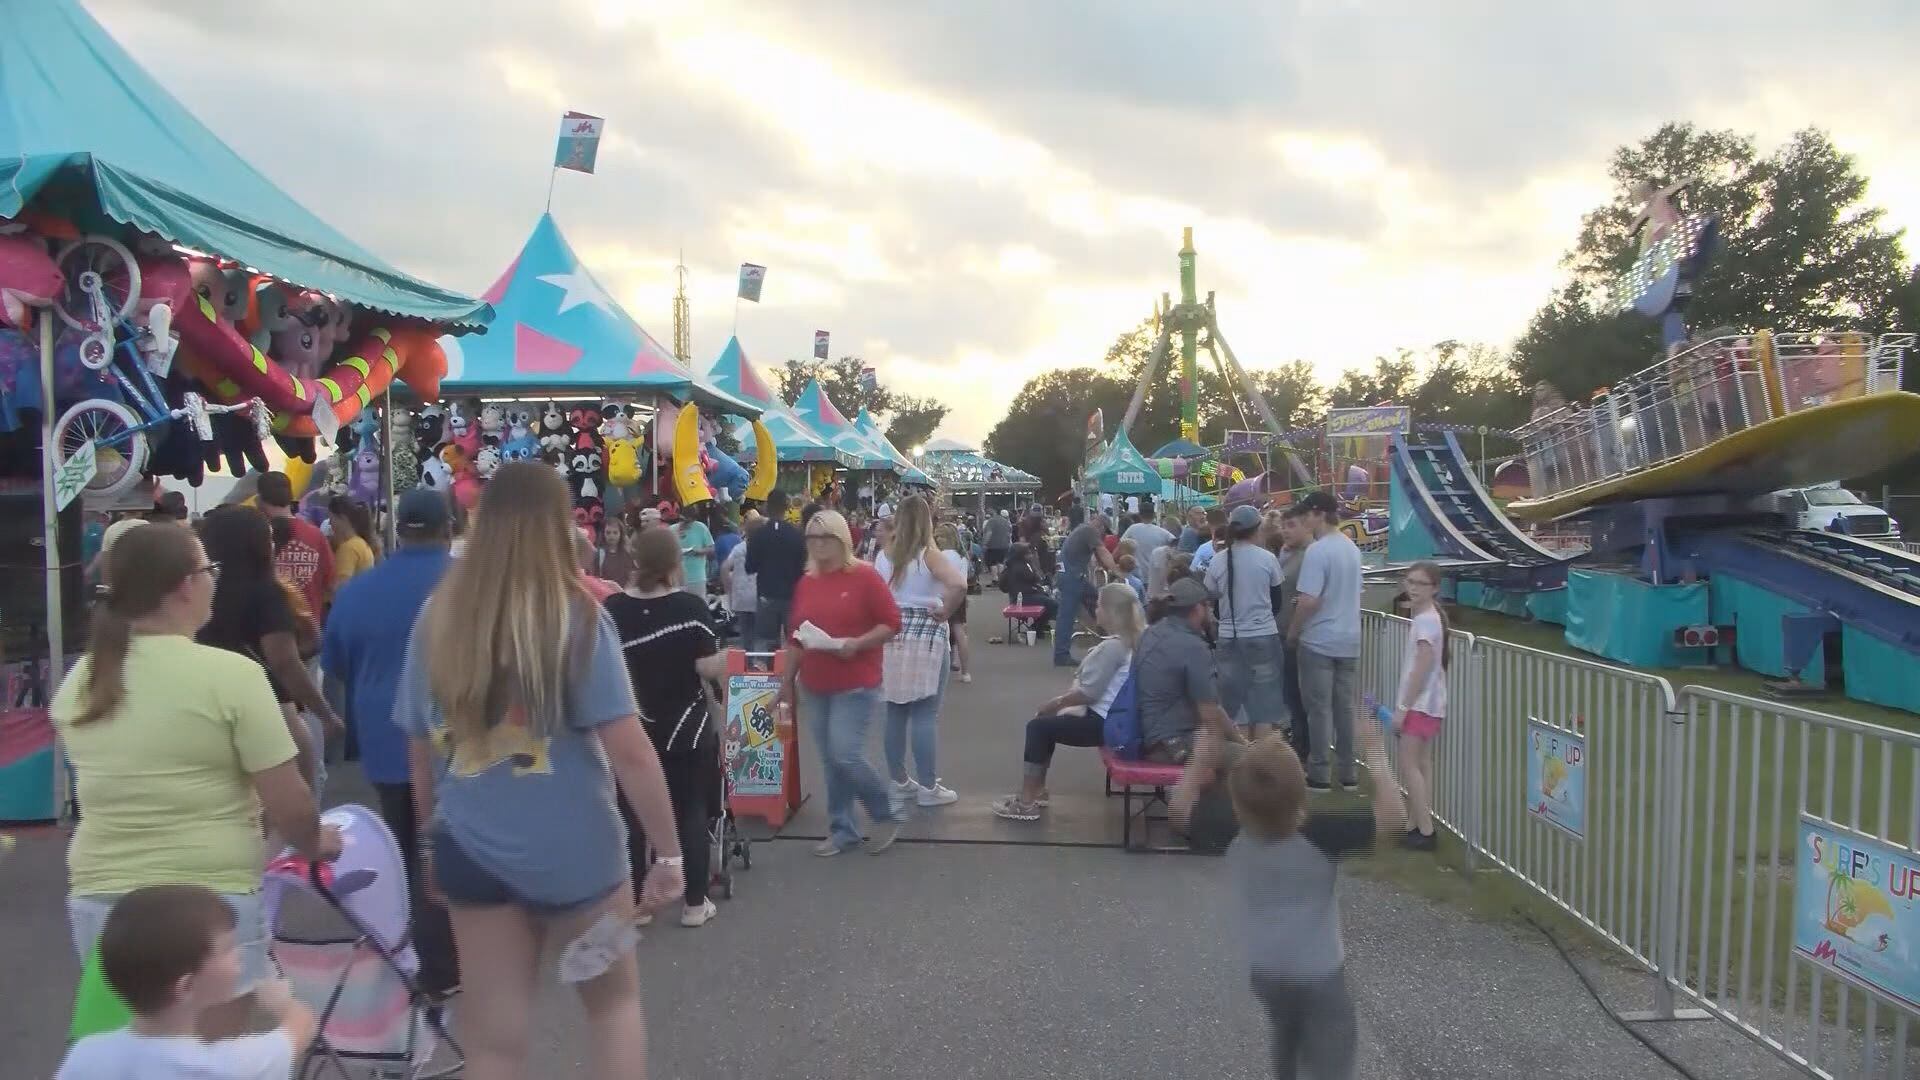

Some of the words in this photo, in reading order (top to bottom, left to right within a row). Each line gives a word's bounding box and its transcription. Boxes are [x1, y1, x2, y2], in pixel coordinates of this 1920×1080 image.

[1117, 471, 1145, 483] ENTER
[750, 679, 782, 689] WALKOVE
[1565, 743, 1580, 766] UP
[1813, 836, 1881, 886] SURF'S
[1889, 863, 1920, 900] UP
